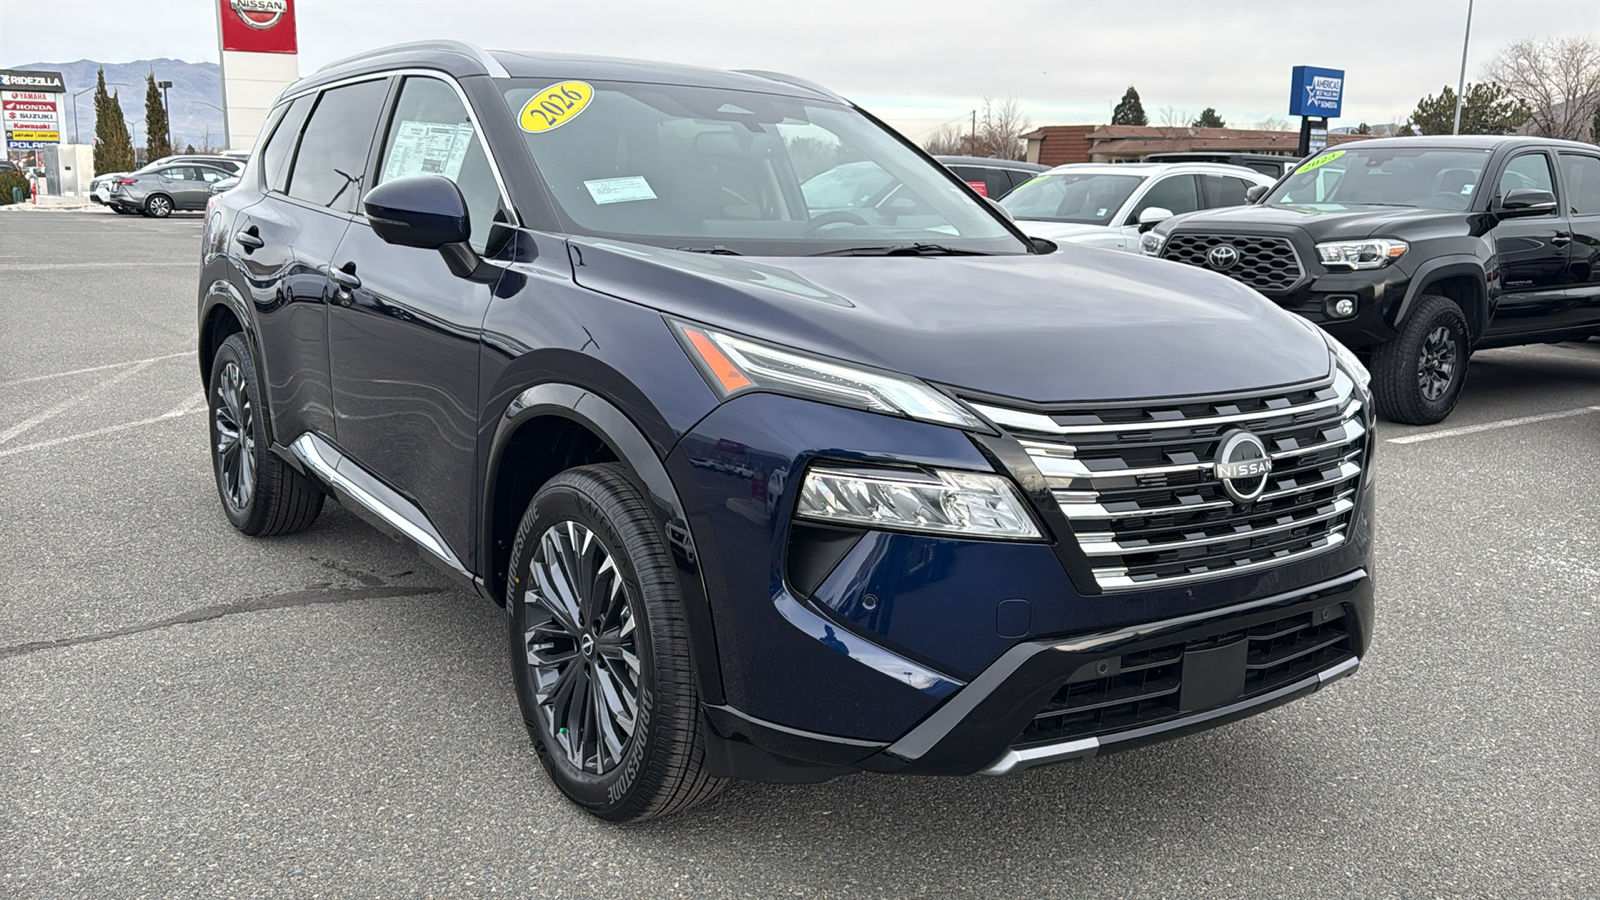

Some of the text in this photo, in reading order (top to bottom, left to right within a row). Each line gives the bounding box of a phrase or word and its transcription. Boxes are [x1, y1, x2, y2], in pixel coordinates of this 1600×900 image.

[237, 0, 282, 9] NISSAN
[10, 76, 61, 86] RIDEZILLA
[530, 85, 582, 126] 2026
[1219, 460, 1272, 477] NISSAN
[506, 502, 540, 617] BRIDGESTONE
[607, 685, 654, 805] BRIDGESTONE
